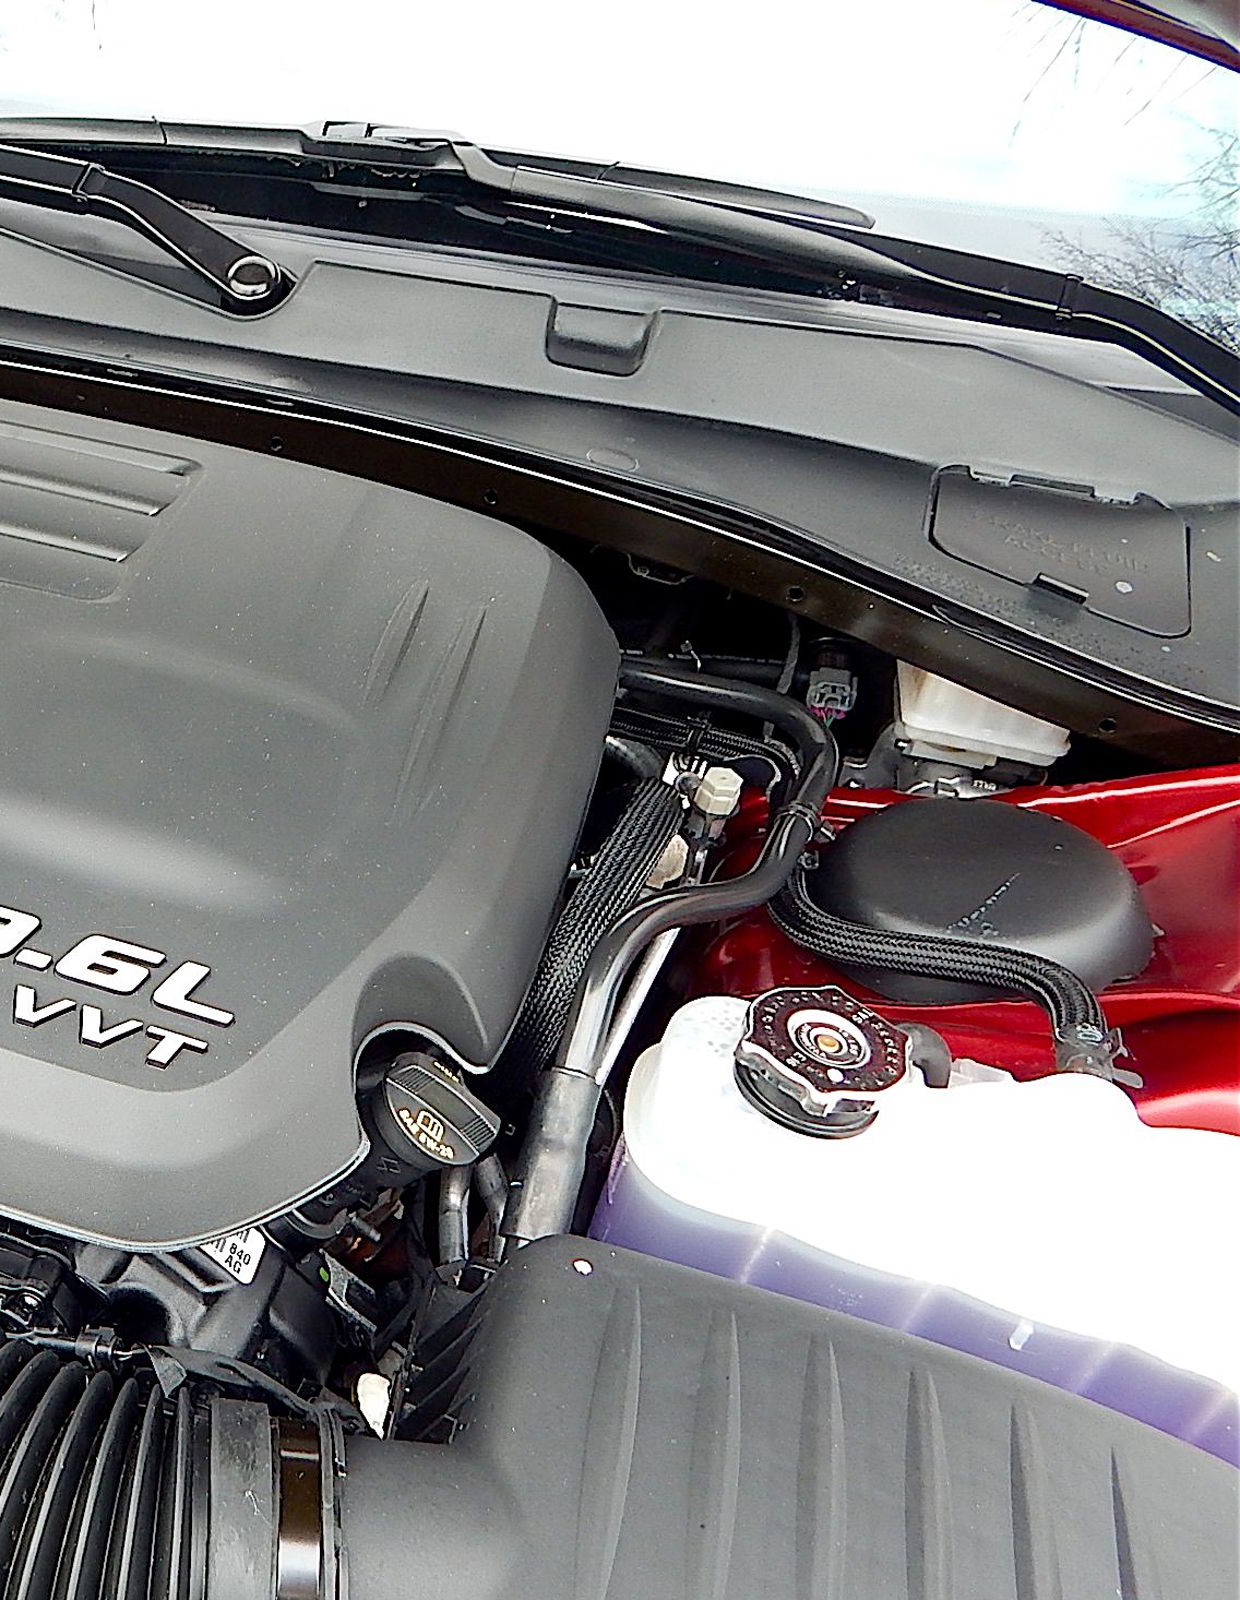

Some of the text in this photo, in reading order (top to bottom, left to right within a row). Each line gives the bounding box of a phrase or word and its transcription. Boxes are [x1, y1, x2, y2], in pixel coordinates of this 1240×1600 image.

[13, 984, 209, 1070] VVT
[224, 1254, 242, 1275] AG
[229, 1242, 251, 1266] 840
